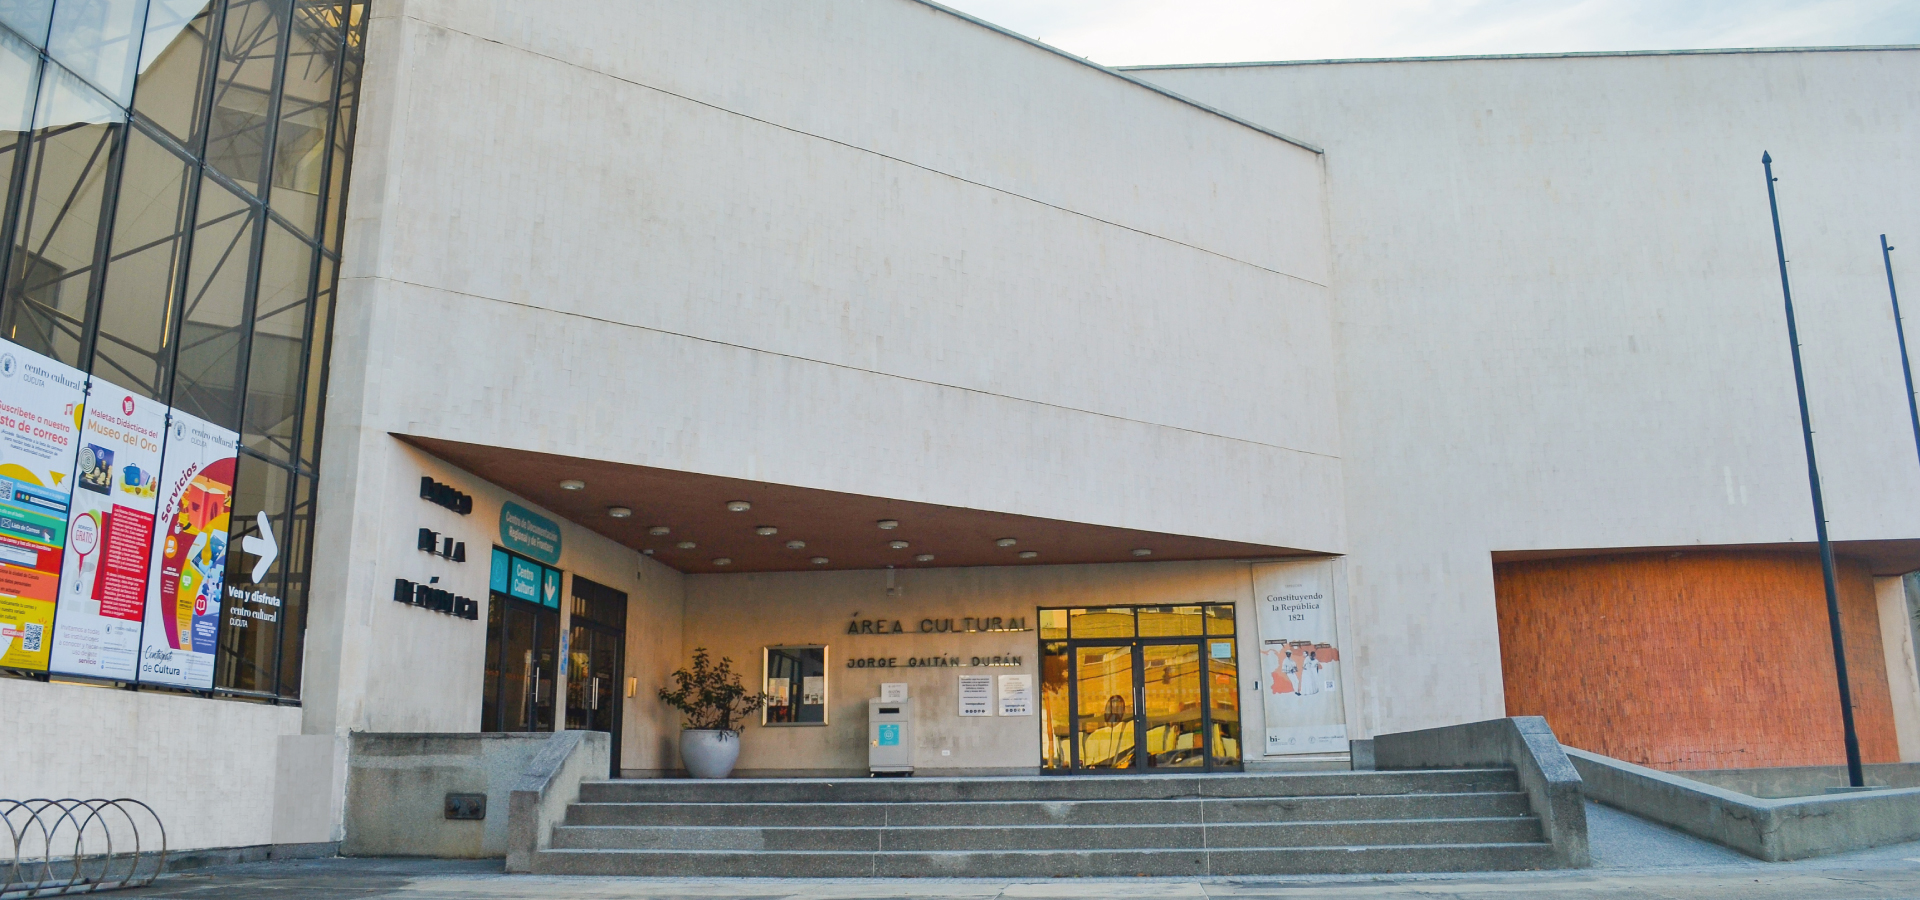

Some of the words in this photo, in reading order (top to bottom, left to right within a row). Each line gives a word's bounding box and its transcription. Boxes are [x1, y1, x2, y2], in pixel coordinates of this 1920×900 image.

[24, 373, 45, 388] CÚCUTA
[25, 363, 50, 378] centro
[51, 374, 80, 391] cultural
[44, 418, 70, 433] nuestra
[90, 408, 116, 424] Maletas
[116, 417, 148, 434] Didácticas
[148, 428, 159, 439] del
[18, 420, 31, 433] de
[33, 427, 69, 446] correos
[87, 418, 121, 440] Museo
[122, 432, 138, 446] del
[140, 437, 158, 453] Oro
[191, 428, 211, 441] centro
[212, 435, 234, 449] cultural
[161, 461, 197, 523] Servicios
[11, 522, 21, 530] Lista
[505, 511, 521, 526] Centro
[520, 518, 527, 529] de
[526, 520, 558, 542] Documentación
[75, 529, 93, 544] GRATIS
[508, 525, 528, 542] Regional
[527, 535, 531, 546] y
[530, 535, 537, 544] de
[536, 537, 554, 553] Frontera
[516, 563, 534, 581] Centro
[228, 585, 244, 599] Ven
[244, 591, 250, 602] y
[251, 590, 281, 607] disfruta
[514, 578, 535, 597] Cultural
[1266, 592, 1323, 603] Constituyendo
[230, 606, 251, 617] centro
[252, 608, 277, 622] cultural
[1281, 603, 1320, 612] República
[229, 616, 248, 628] CÚCUTA
[847, 611, 904, 634] ÁREA
[920, 616, 1034, 634] CULTURAL
[142, 662, 153, 674] de
[153, 664, 181, 676] Cultura
[847, 657, 898, 668] JORGE
[908, 652, 960, 667] GAITÁN
[971, 652, 1022, 667] DURÁN
